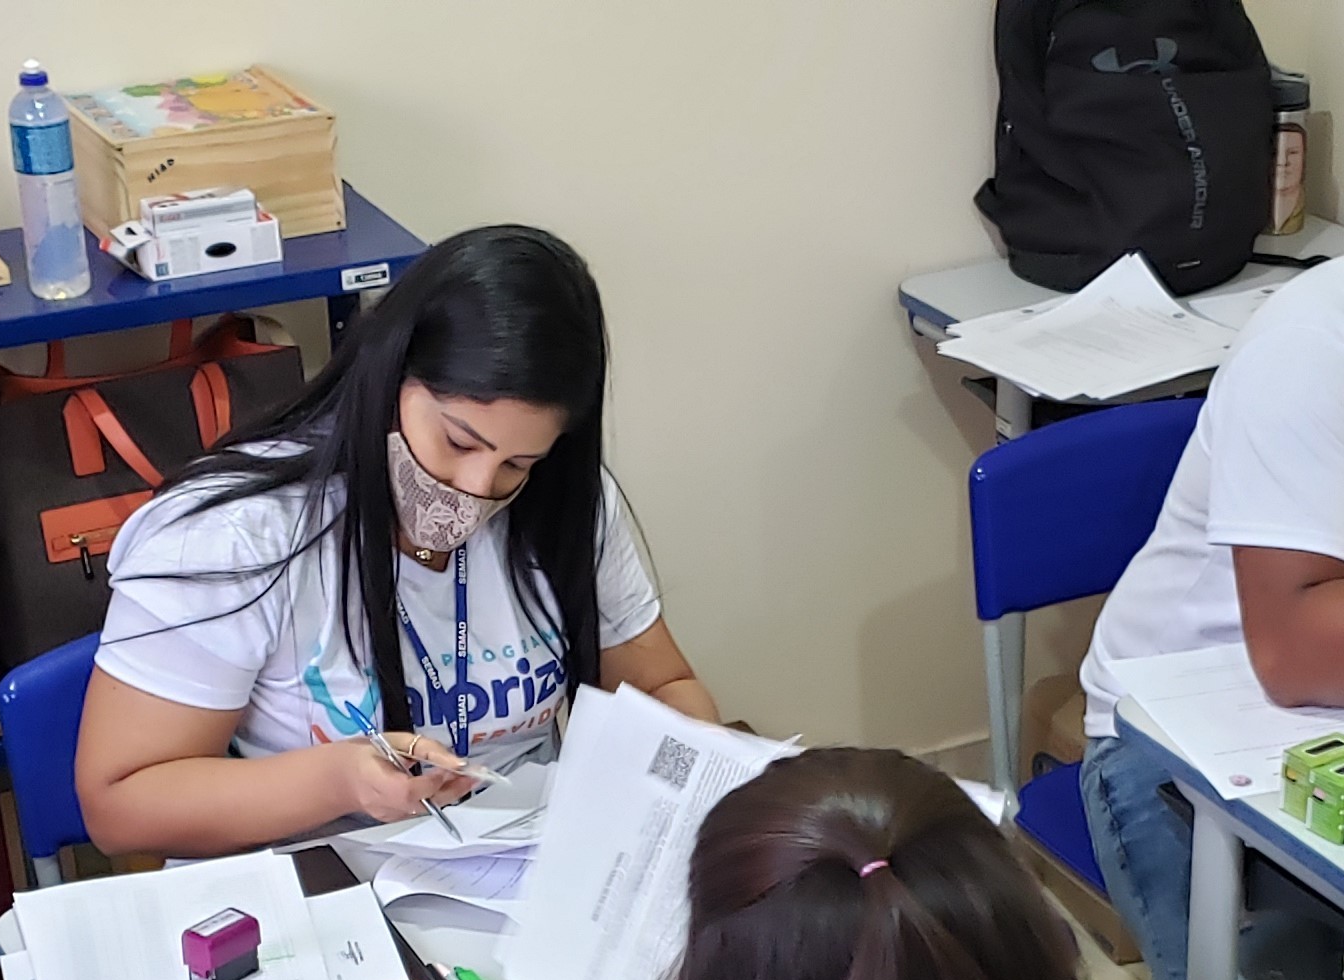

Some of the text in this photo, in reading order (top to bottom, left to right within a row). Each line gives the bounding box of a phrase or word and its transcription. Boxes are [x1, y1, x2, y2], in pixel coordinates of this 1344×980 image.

[1161, 78, 1207, 229] UNDER ARMOUR
[458, 549, 466, 585] SEMAD
[458, 621, 467, 658] SEMAD
[421, 655, 442, 690] SEMAD
[458, 694, 467, 729] SEMAD
